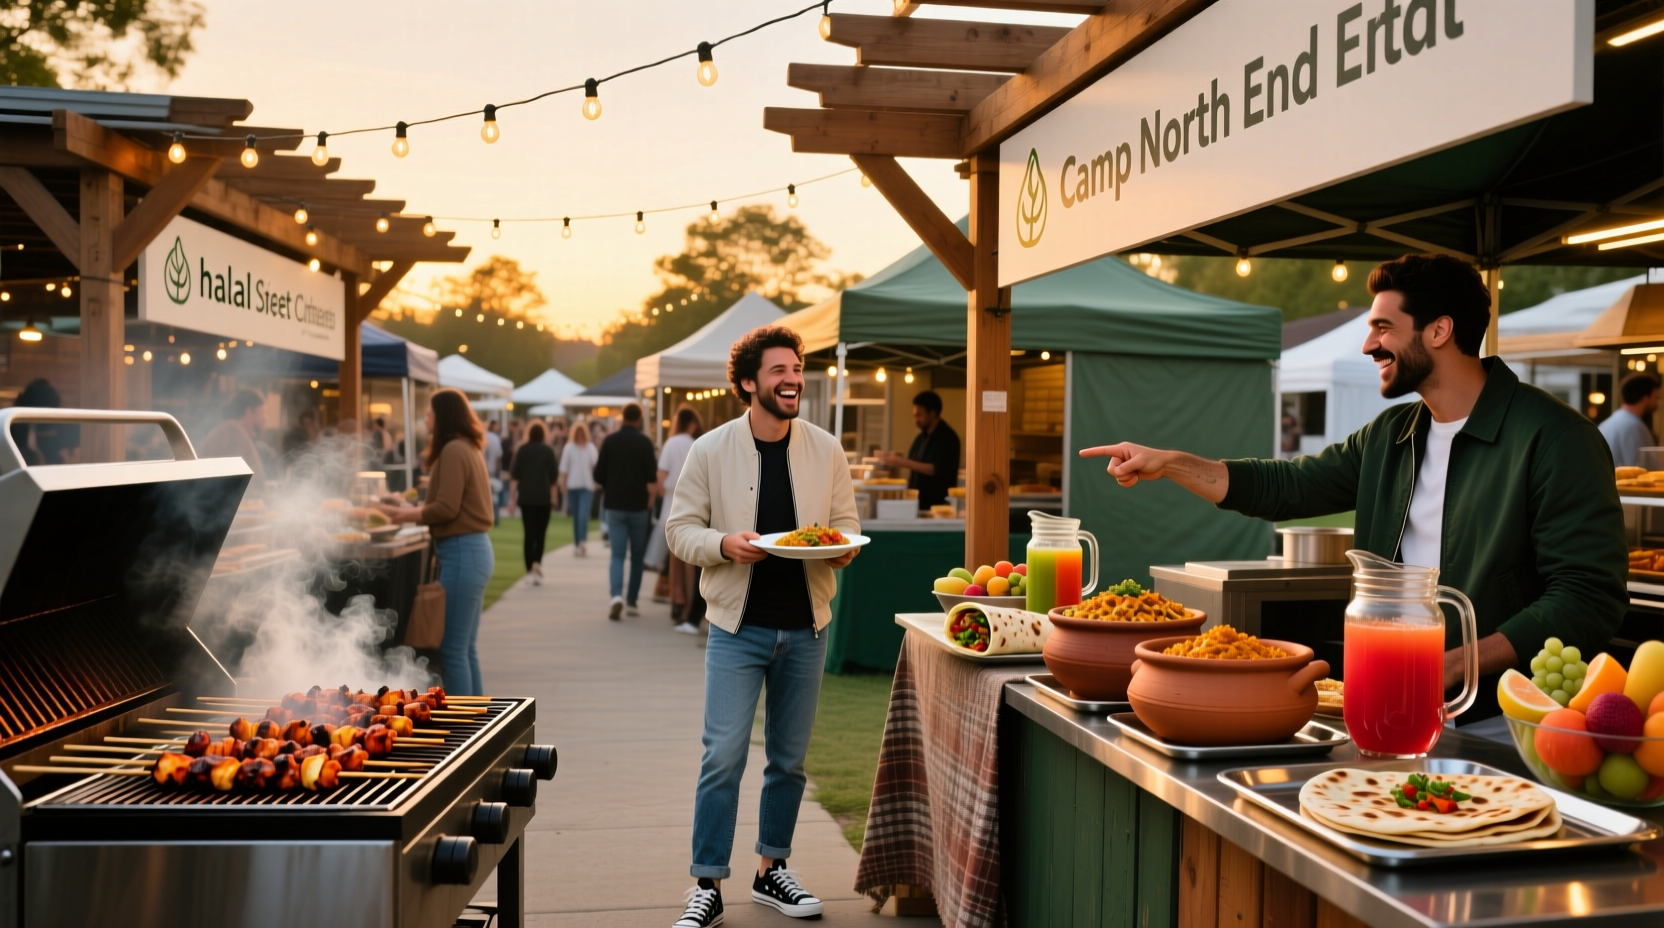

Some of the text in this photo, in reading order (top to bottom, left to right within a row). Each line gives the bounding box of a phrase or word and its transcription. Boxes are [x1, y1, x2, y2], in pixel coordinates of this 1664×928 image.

[1060, 142, 1132, 208] Camp
[1140, 78, 1230, 174] North
[1243, 24, 1318, 129] End
[200, 257, 251, 310] halal
